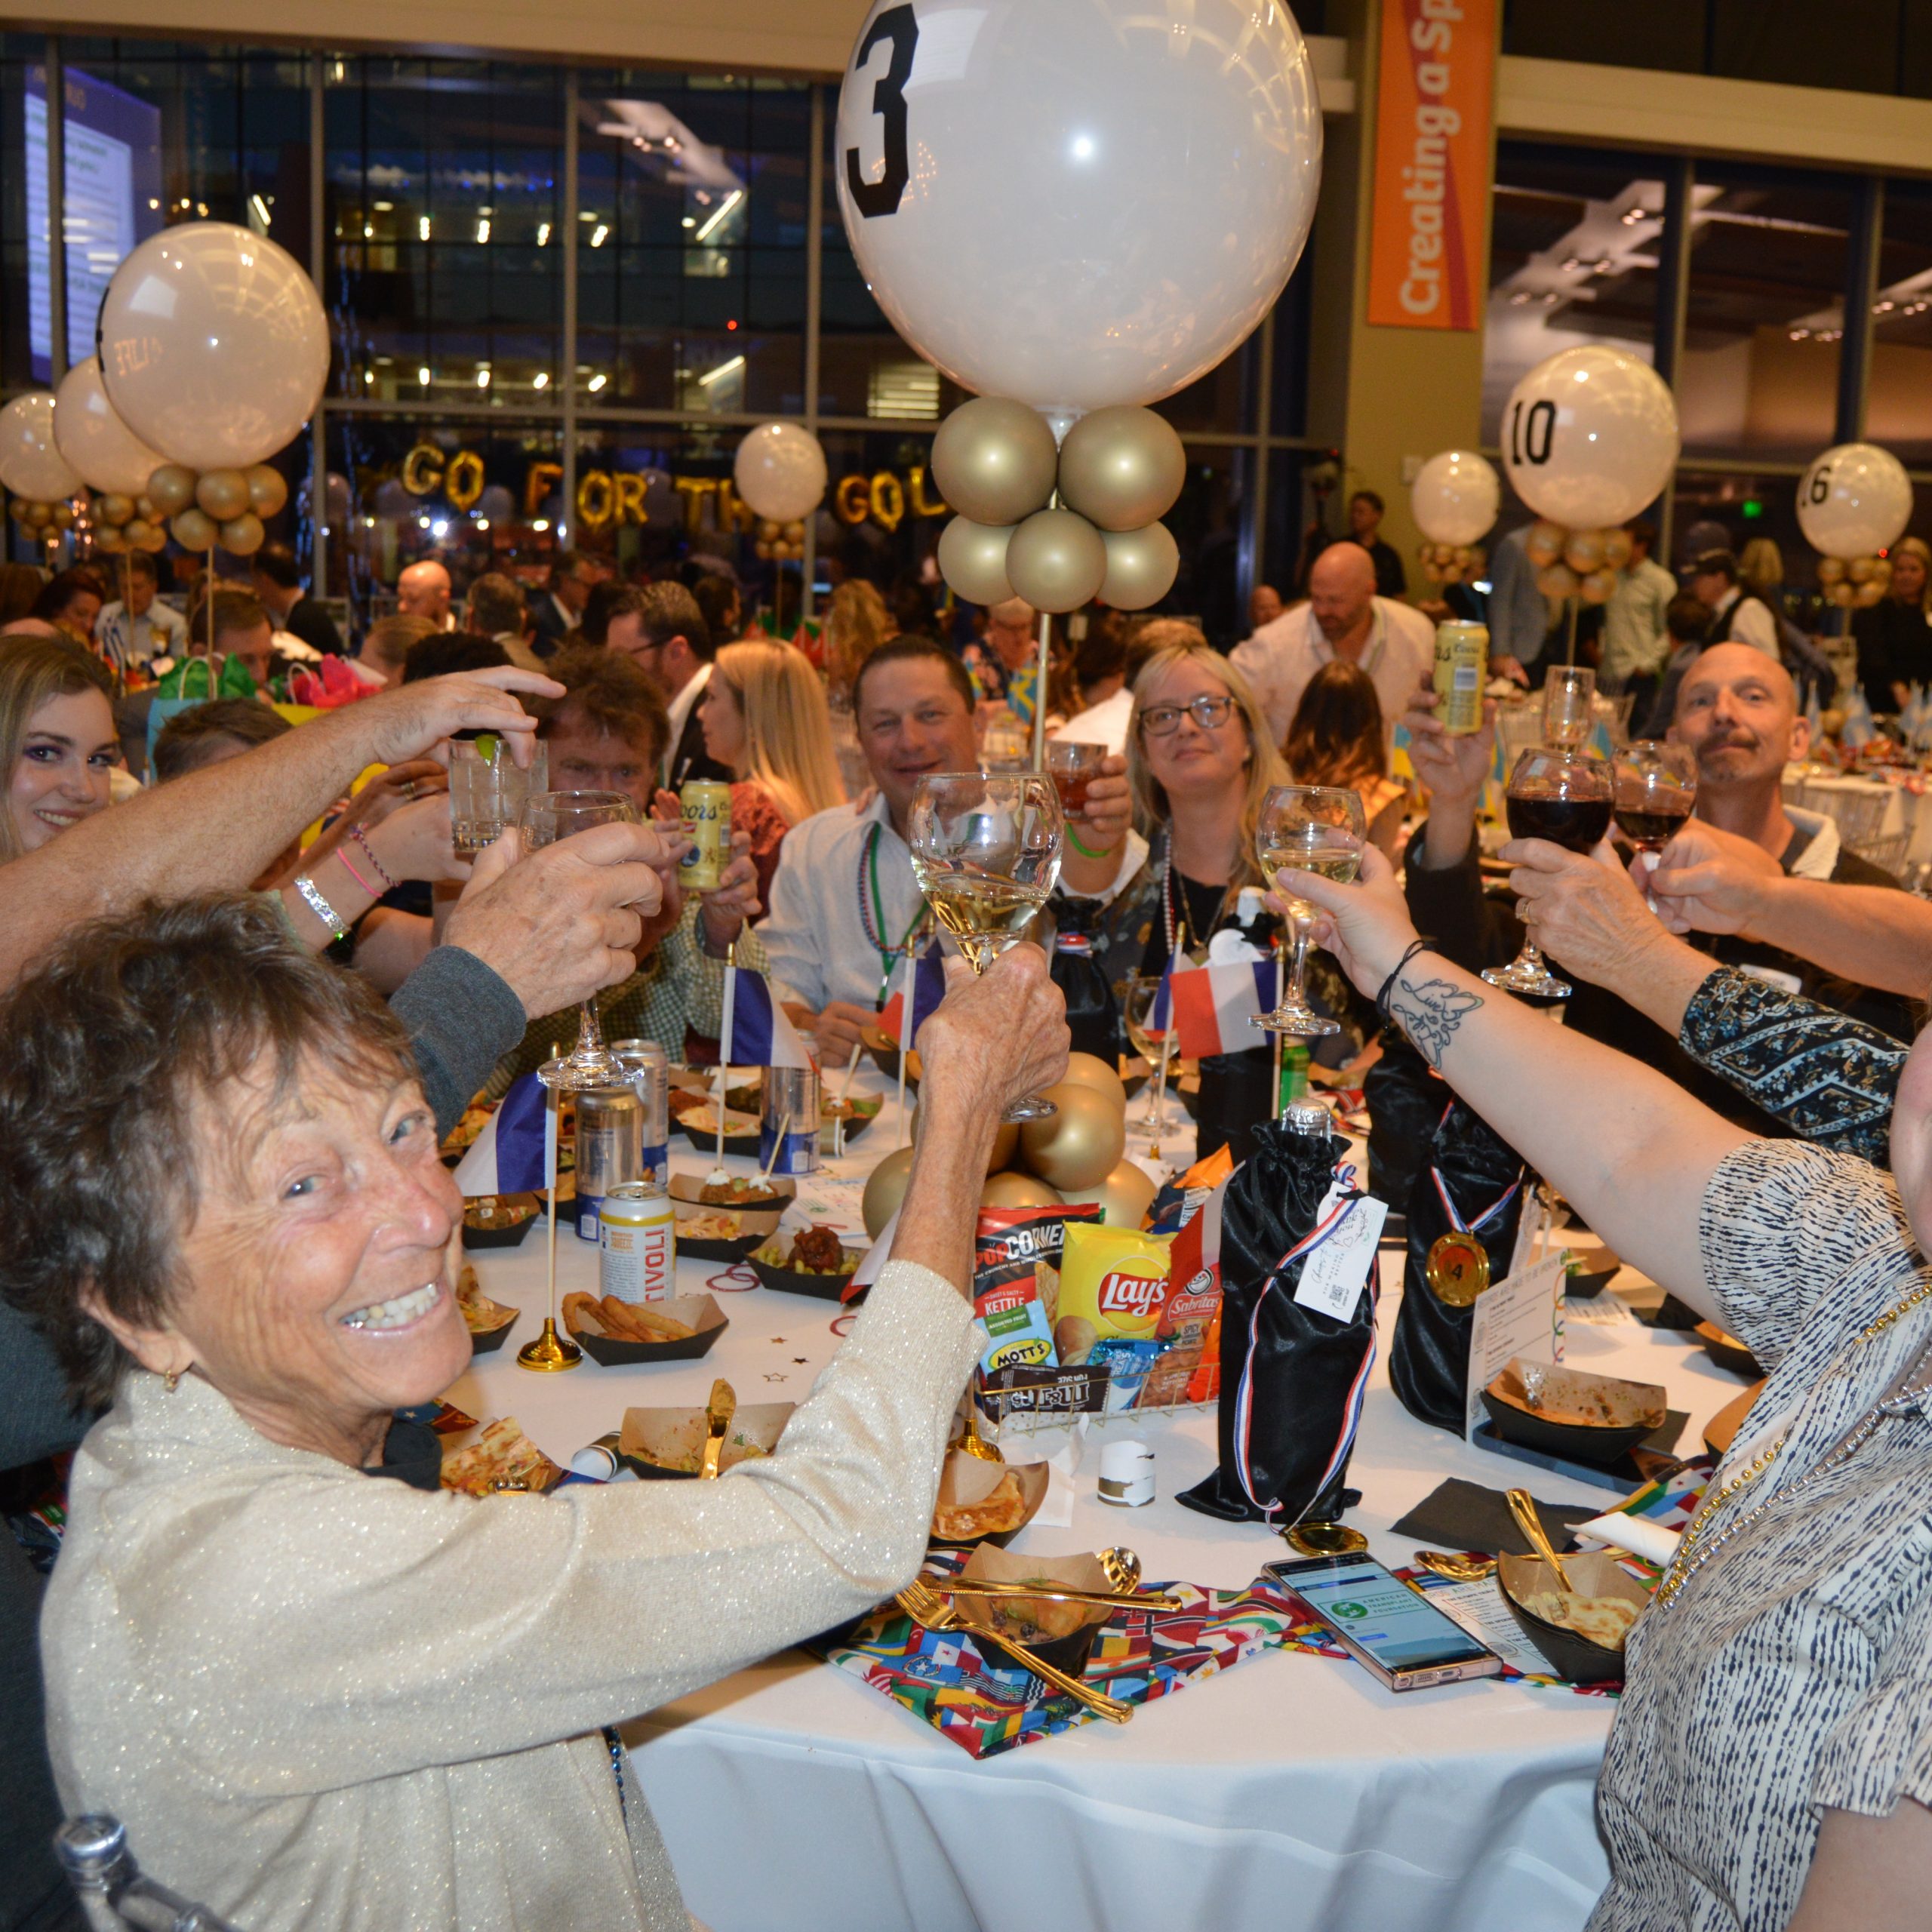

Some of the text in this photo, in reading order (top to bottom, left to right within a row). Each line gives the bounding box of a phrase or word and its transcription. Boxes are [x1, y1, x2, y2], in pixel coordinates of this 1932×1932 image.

[1417, 63, 1450, 96] a
[846, 3, 919, 219] 3
[1400, 104, 1461, 315] Creating
[1513, 399, 1556, 464] 10
[402, 444, 948, 533] GO FOR TH GOL
[1803, 466, 1831, 506] 6
[680, 804, 717, 821] oors
[645, 1229, 665, 1303] TIVOLI
[976, 1223, 1066, 1273] POPCORNE
[1102, 1272, 1169, 1317] Lay's
[1452, 1264, 1463, 1280] 4
[1363, 1593, 1407, 1604] AMERICAN
